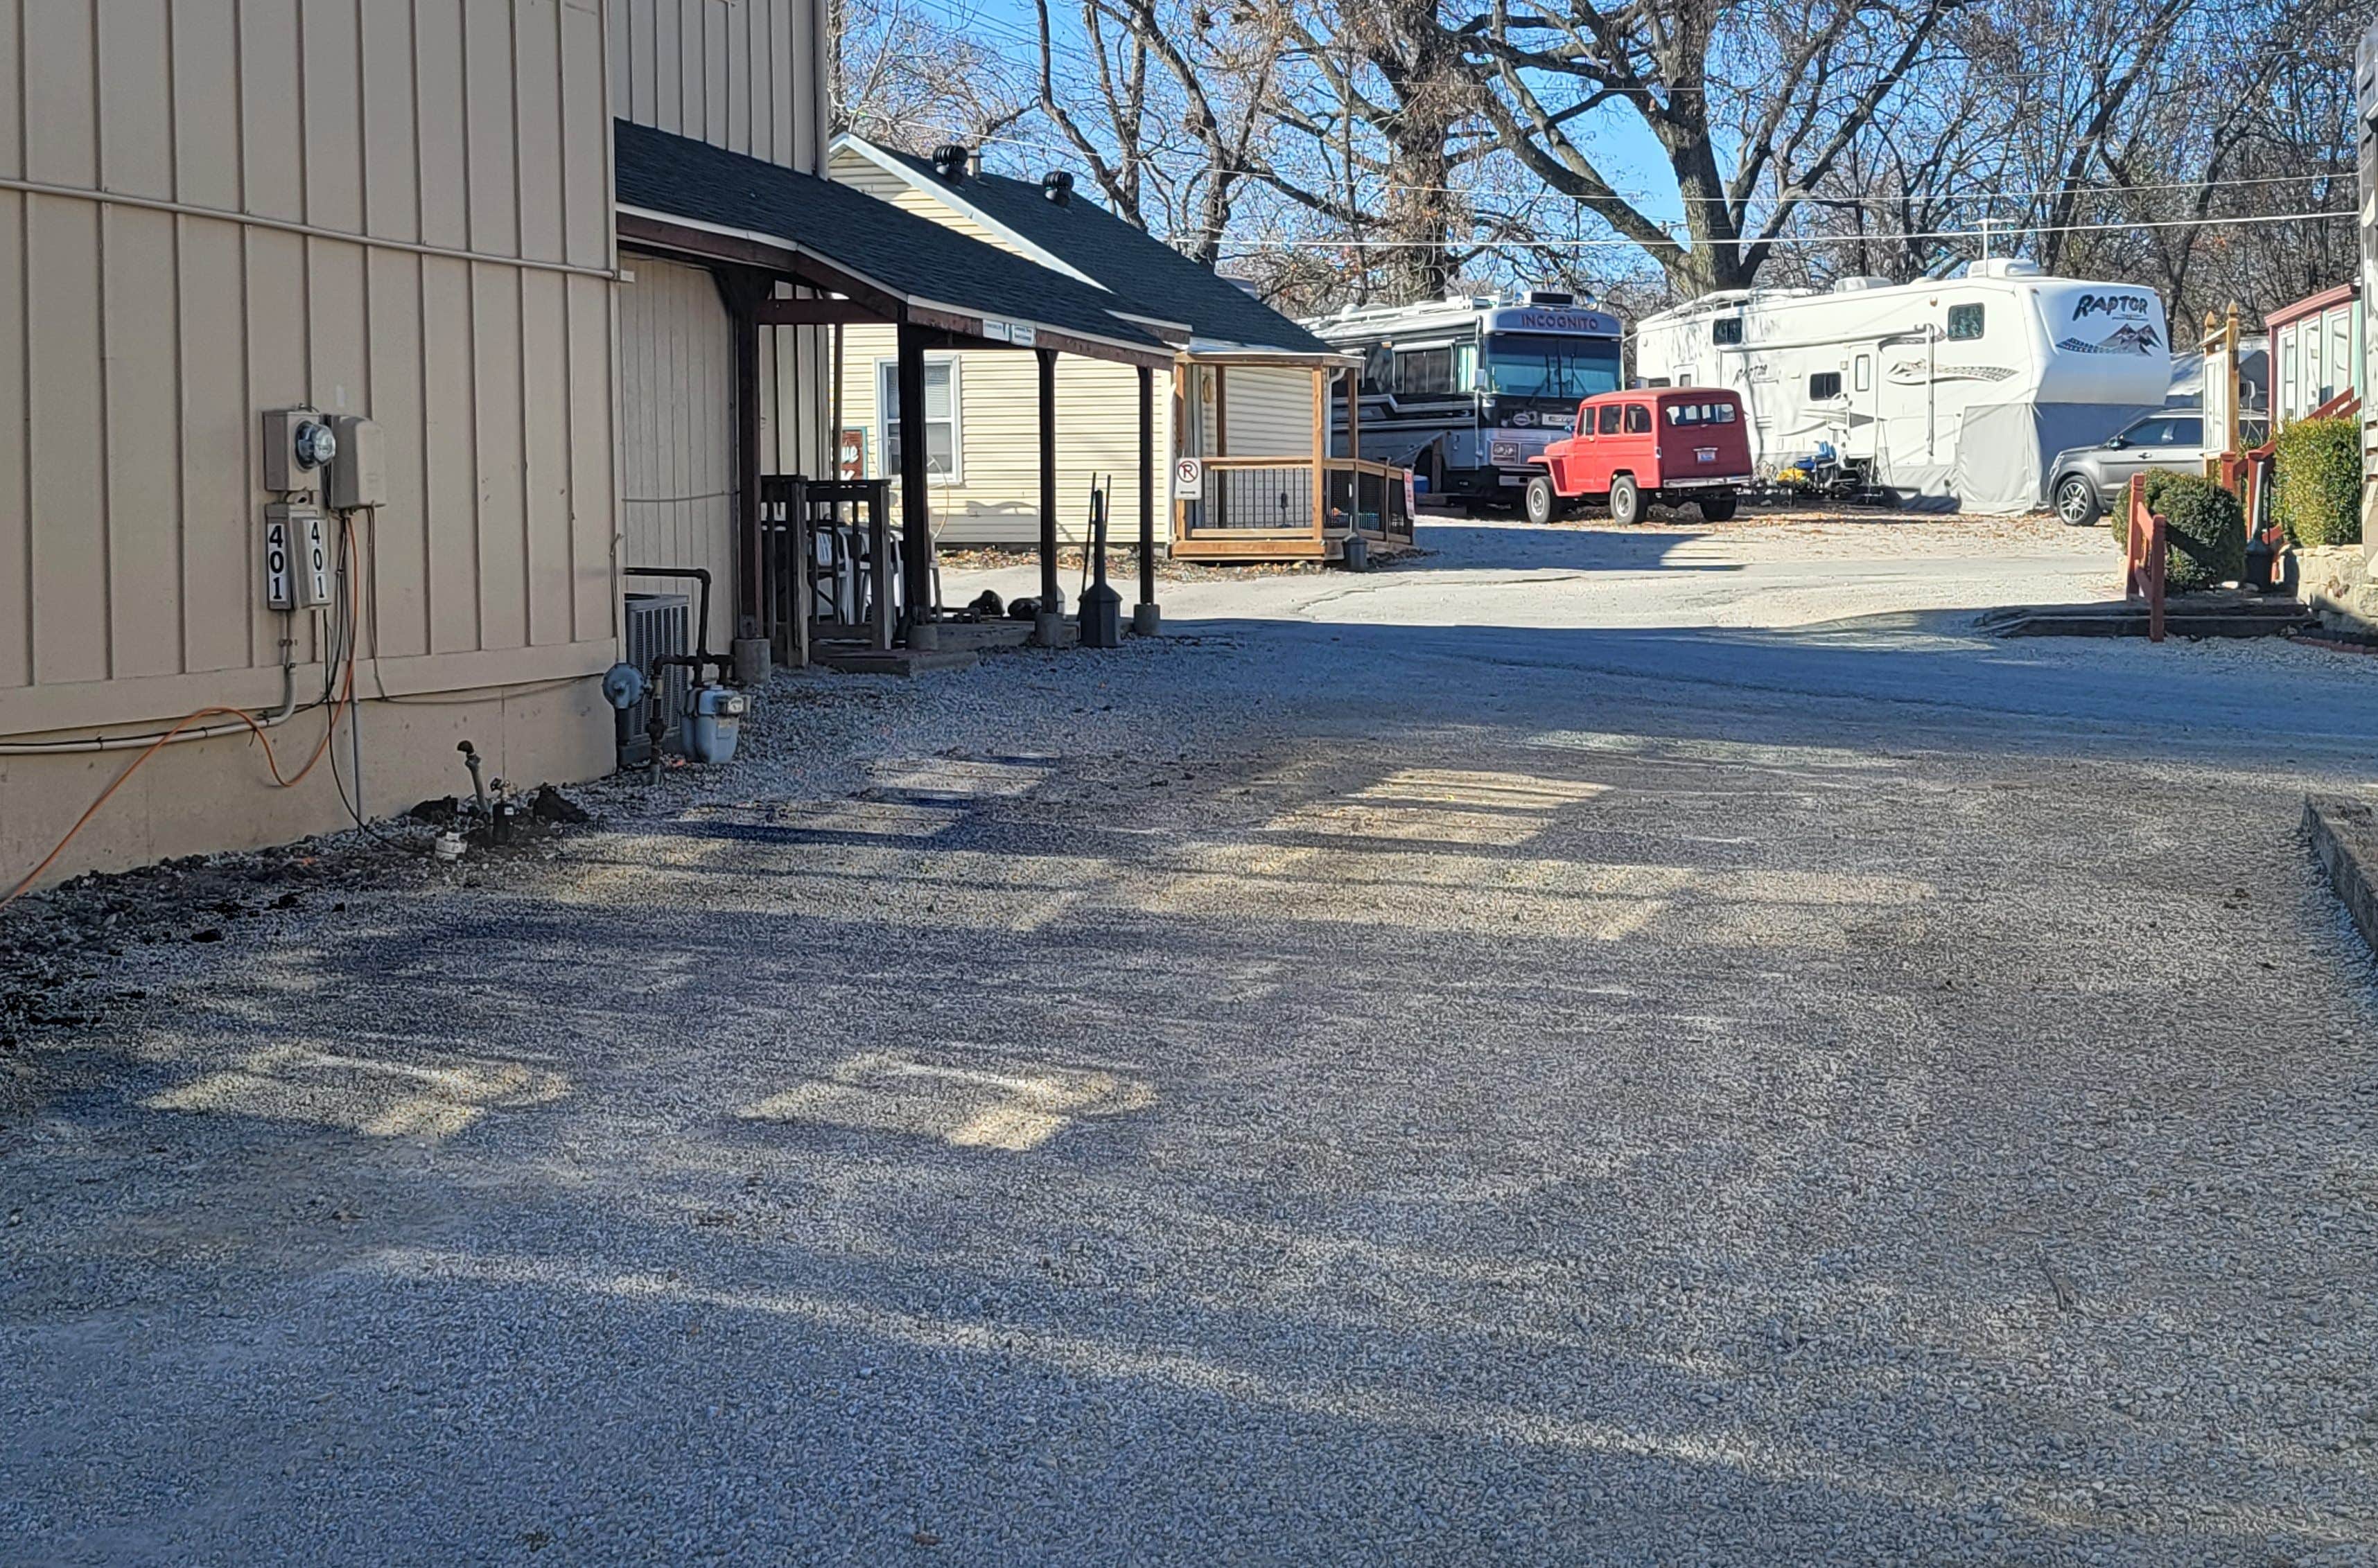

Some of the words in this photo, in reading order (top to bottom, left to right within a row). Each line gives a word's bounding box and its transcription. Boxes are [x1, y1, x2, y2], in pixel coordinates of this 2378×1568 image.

[1521, 315, 1598, 330] INCOGNITO
[2072, 294, 2149, 321] RAPTOR
[269, 525, 283, 600] 401
[311, 521, 326, 599] 401
